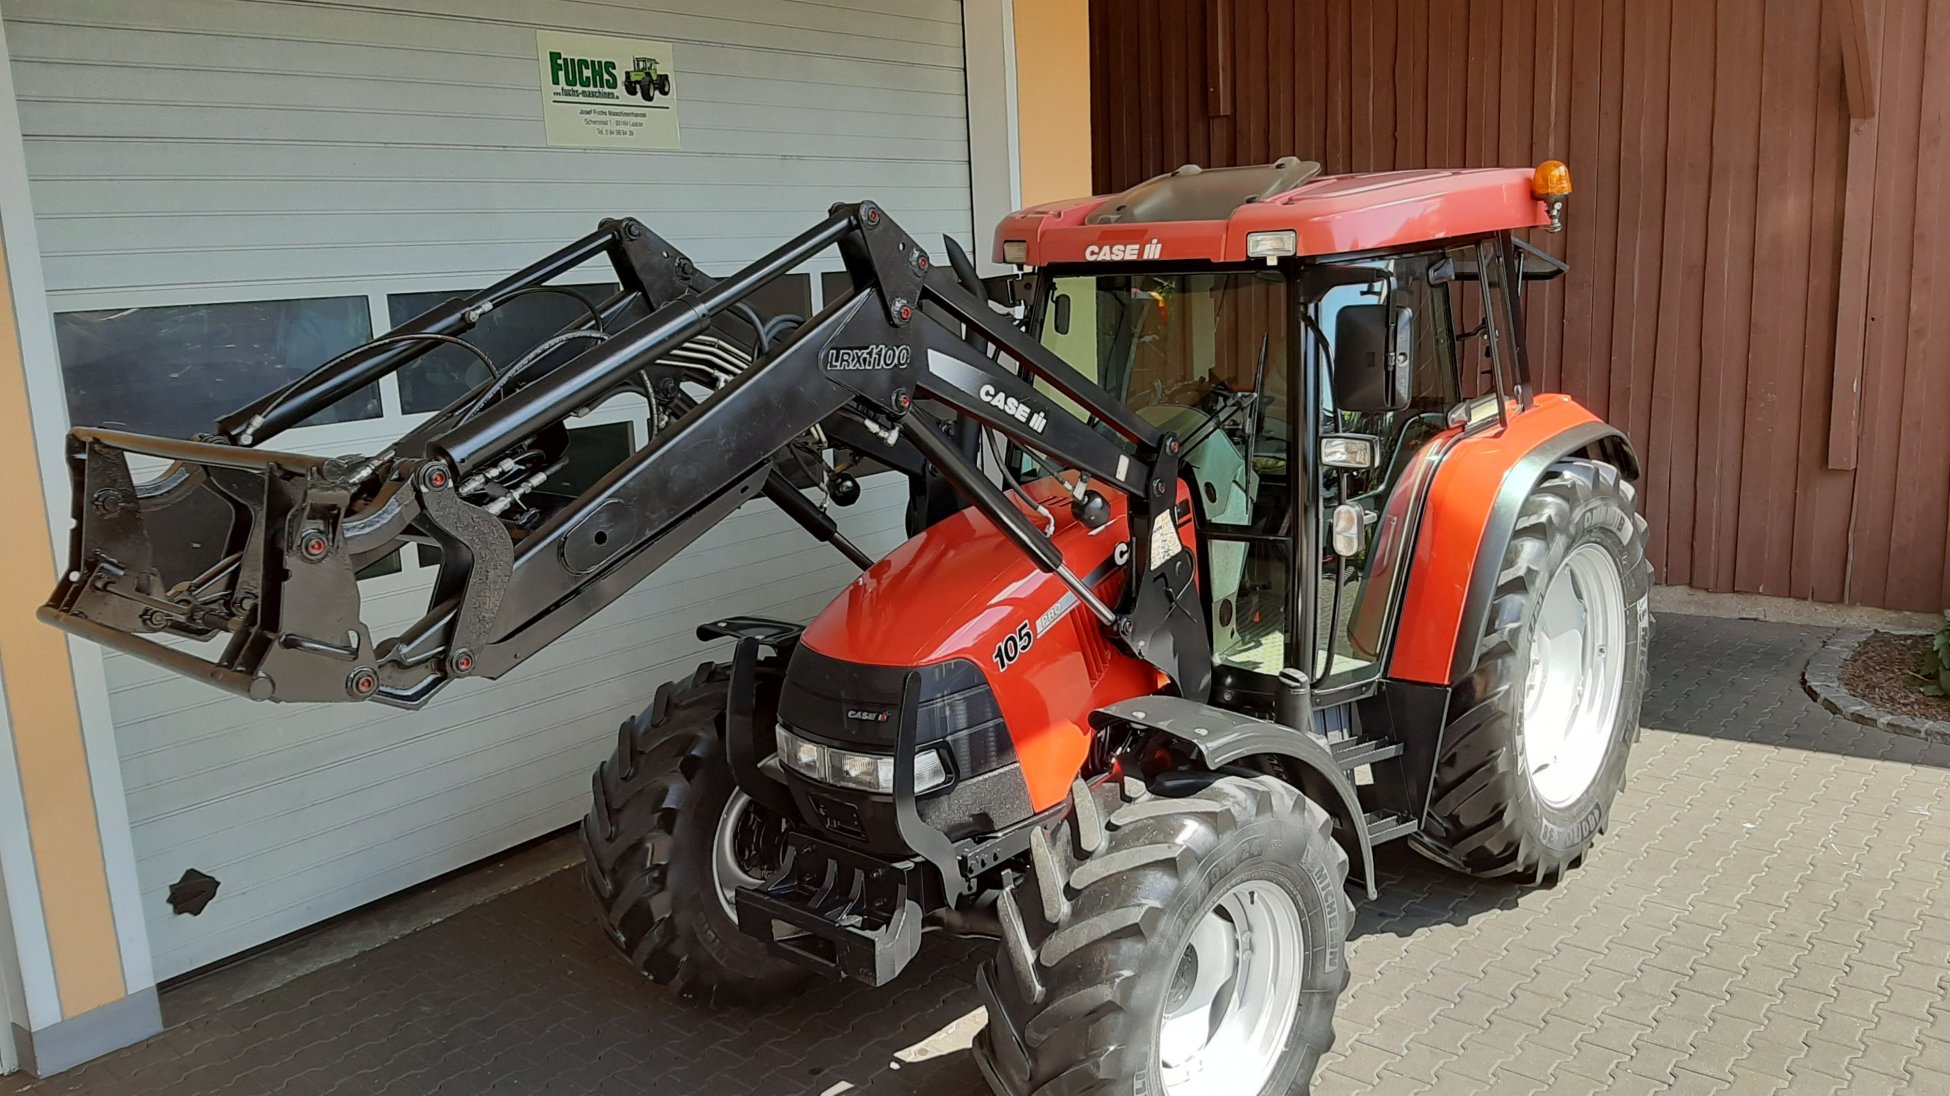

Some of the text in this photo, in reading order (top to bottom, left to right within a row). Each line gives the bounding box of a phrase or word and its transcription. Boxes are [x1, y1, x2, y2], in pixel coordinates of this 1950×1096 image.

[549, 51, 618, 89] FUCHS
[1085, 244, 1139, 261] CASE
[827, 345, 910, 370] LRX1100
[980, 384, 1031, 423] CASE
[992, 618, 1033, 672] 105
[847, 710, 878, 721] CASE
